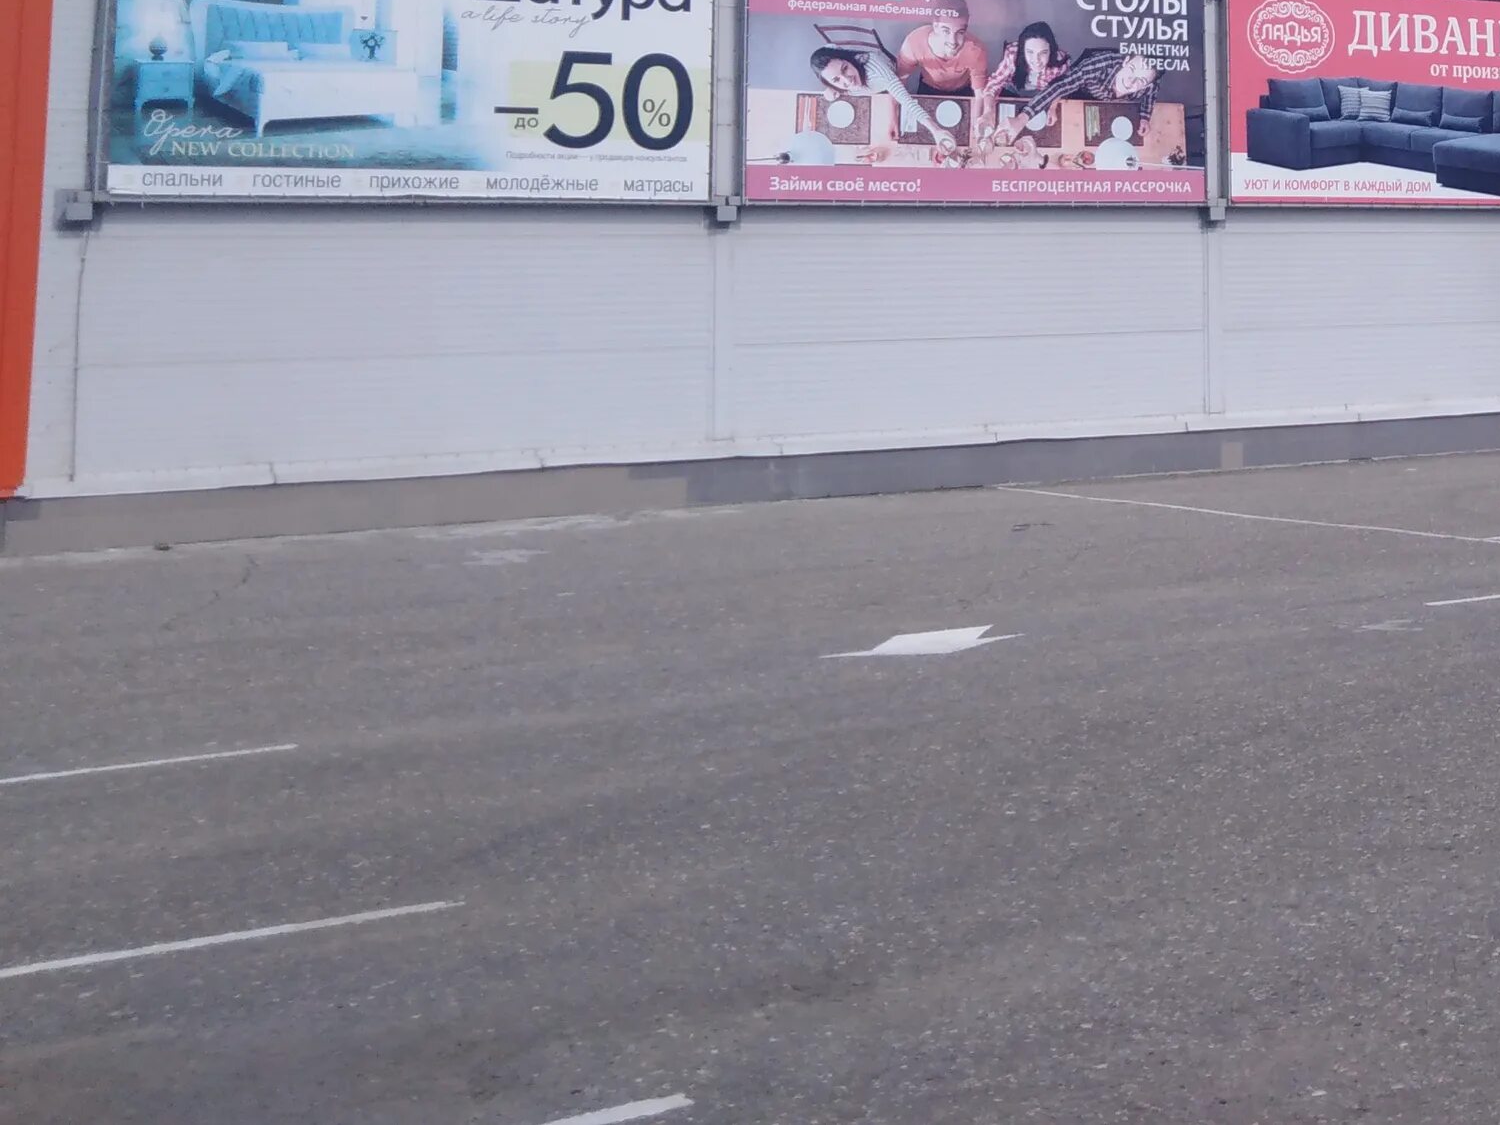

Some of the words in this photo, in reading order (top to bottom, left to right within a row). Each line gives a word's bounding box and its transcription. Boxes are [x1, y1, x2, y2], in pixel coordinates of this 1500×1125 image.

[869, 2, 932, 17] мебельная
[934, 8, 959, 18] сеть
[531, 8, 592, 38] story
[1091, 15, 1188, 42] СТУЛЬЯ
[1120, 42, 1189, 57] БАНКЕТКИ
[1142, 58, 1190, 72] КРЕСЛА
[1430, 63, 1449, 77] от
[514, 117, 539, 130] до
[171, 141, 222, 156] NEW
[228, 141, 356, 159] COLLECTION
[141, 172, 223, 187] спальни
[252, 173, 342, 188] гостиные
[369, 174, 460, 194] прихожие
[486, 175, 599, 193] молодёжные
[623, 178, 694, 196] матрасы
[769, 176, 822, 195] Займи
[826, 177, 864, 193] своё
[868, 177, 922, 193] место!
[991, 179, 1111, 196] БЕСПРОЦЕНТНАЯ
[1115, 179, 1192, 194] РАССРОЧКА
[1243, 177, 1269, 192] УЮТ
[1273, 179, 1281, 191] И
[1284, 179, 1340, 193] КОМФОРТ
[1344, 180, 1351, 192] В
[1354, 177, 1403, 194] КАЖДЫЙ
[1405, 181, 1432, 194] ДОМ
